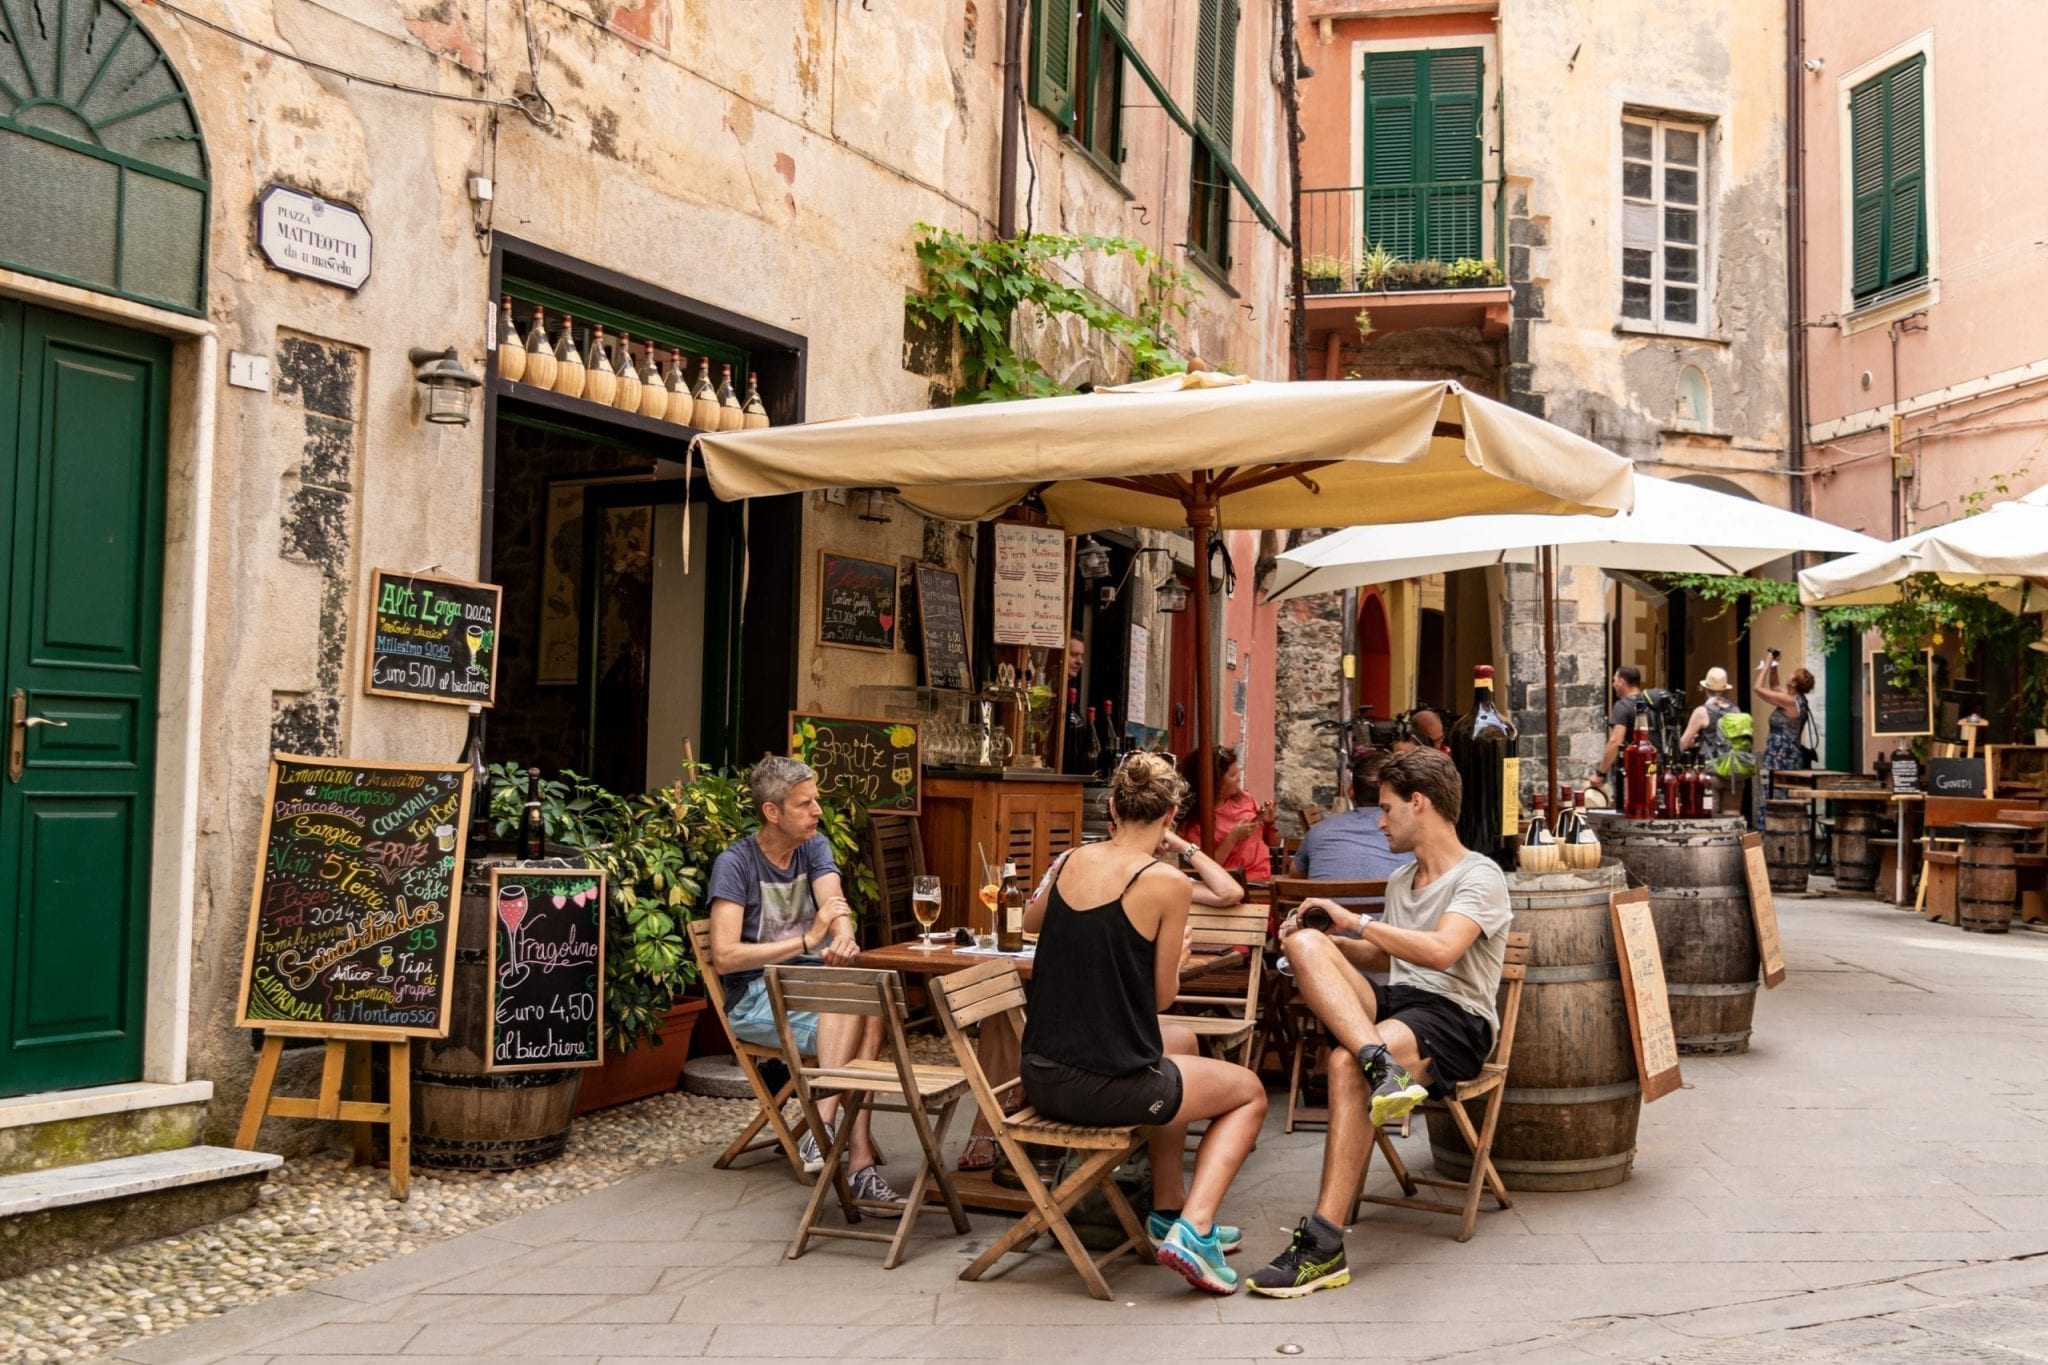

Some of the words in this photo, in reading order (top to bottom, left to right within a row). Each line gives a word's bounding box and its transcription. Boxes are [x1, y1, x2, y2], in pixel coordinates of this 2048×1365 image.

[278, 206, 311, 225] PIAZZA
[277, 221, 357, 259] MATTEOTTI
[284, 243, 298, 259] da
[302, 252, 309, 262] u
[248, 361, 253, 381] 1
[378, 583, 418, 618] Alta
[421, 590, 462, 626] Langa
[439, 672, 450, 690] al
[451, 670, 490, 695] bicchiere
[279, 765, 352, 785] Limoncino
[305, 786, 317, 796] di
[317, 786, 397, 807] Monterosso
[430, 793, 460, 821] Beer
[371, 784, 440, 837] COCKTAILS
[295, 816, 363, 849] Sangria
[273, 843, 312, 874] Vini
[365, 841, 430, 867] SPRITZ
[320, 853, 344, 880] 5
[340, 861, 384, 910] Terre
[400, 861, 448, 885] Irish
[264, 881, 331, 916] Eliseo
[274, 904, 306, 928] red
[310, 906, 355, 926] 2014
[406, 928, 439, 951] 93
[518, 914, 599, 974] Fragolino
[329, 963, 374, 982] Antico
[398, 952, 434, 981] Tipi
[424, 974, 437, 986] di
[255, 965, 324, 1022] CAIPIRINHA
[334, 983, 395, 1005] Limoncino
[393, 975, 437, 1004] Grappe
[332, 1004, 346, 1022] di
[349, 1000, 437, 1025] Monterosso
[549, 992, 595, 1024] 4,50
[496, 1030, 512, 1061] al
[516, 1027, 588, 1060] bicchiere
